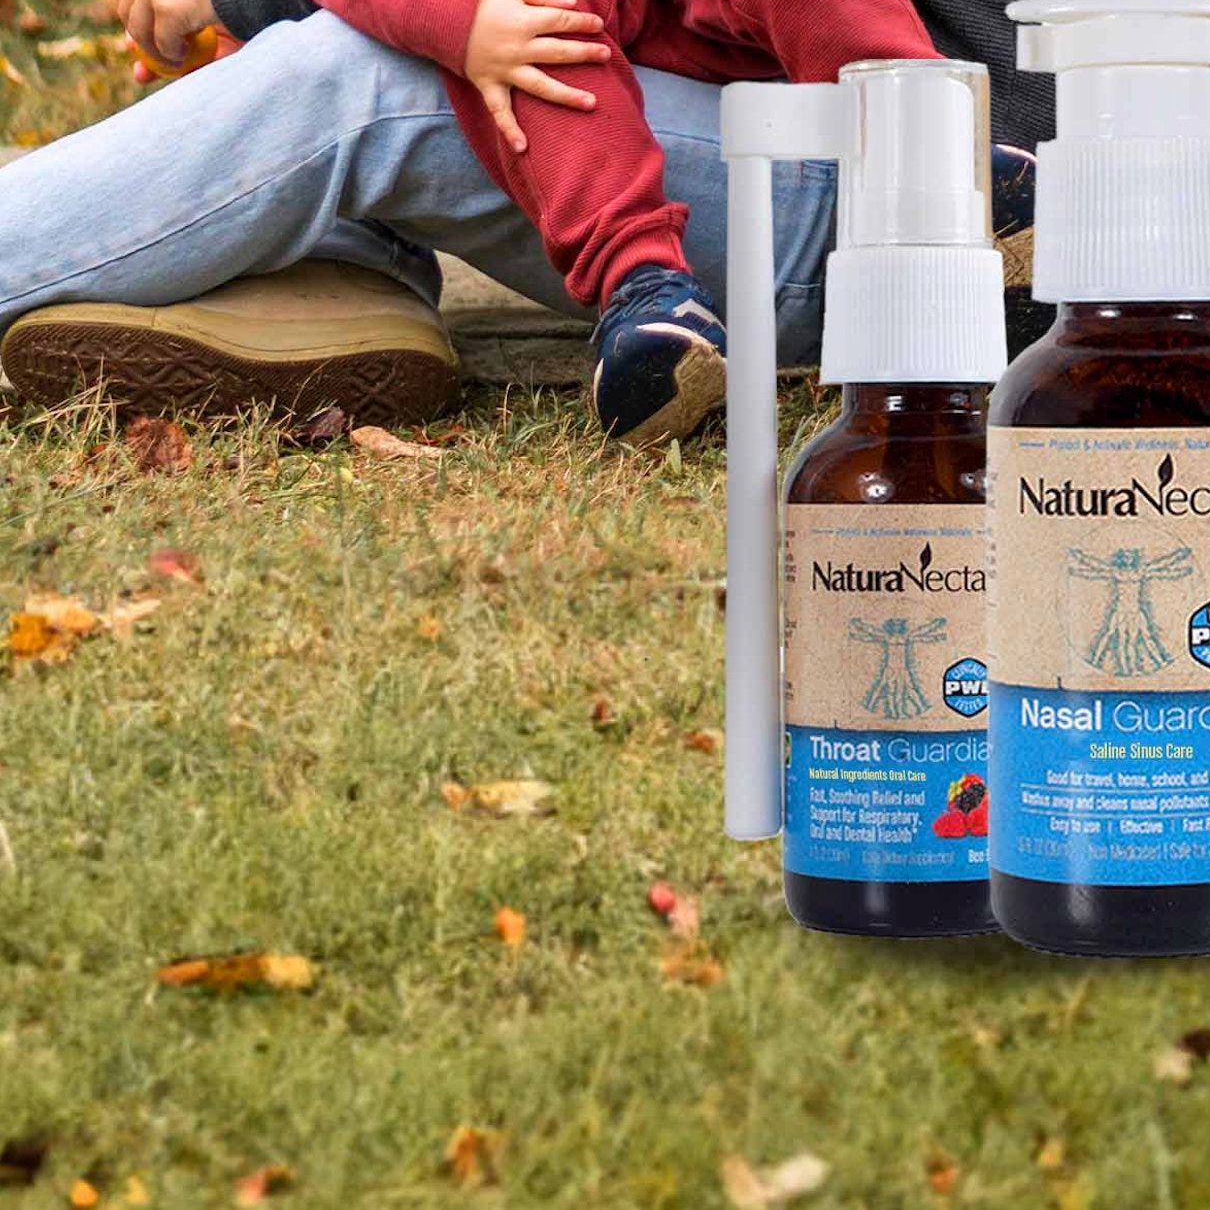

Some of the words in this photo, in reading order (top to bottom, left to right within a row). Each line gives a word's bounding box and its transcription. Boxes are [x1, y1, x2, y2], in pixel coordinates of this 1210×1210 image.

[812, 542, 986, 592] NaturaNecta
[1021, 697, 1102, 730] Nasal
[810, 736, 881, 761] Throat
[887, 737, 990, 763] Guardia
[1089, 743, 1126, 759] Saline
[1130, 743, 1163, 759] Sinus
[1166, 743, 1194, 759] Care
[809, 767, 838, 781] Natural
[840, 768, 888, 783] Ingredients
[889, 769, 906, 782] Oral
[907, 769, 926, 782] Care
[1190, 770, 1209, 785] and
[903, 791, 925, 806] and
[842, 806, 856, 821] for
